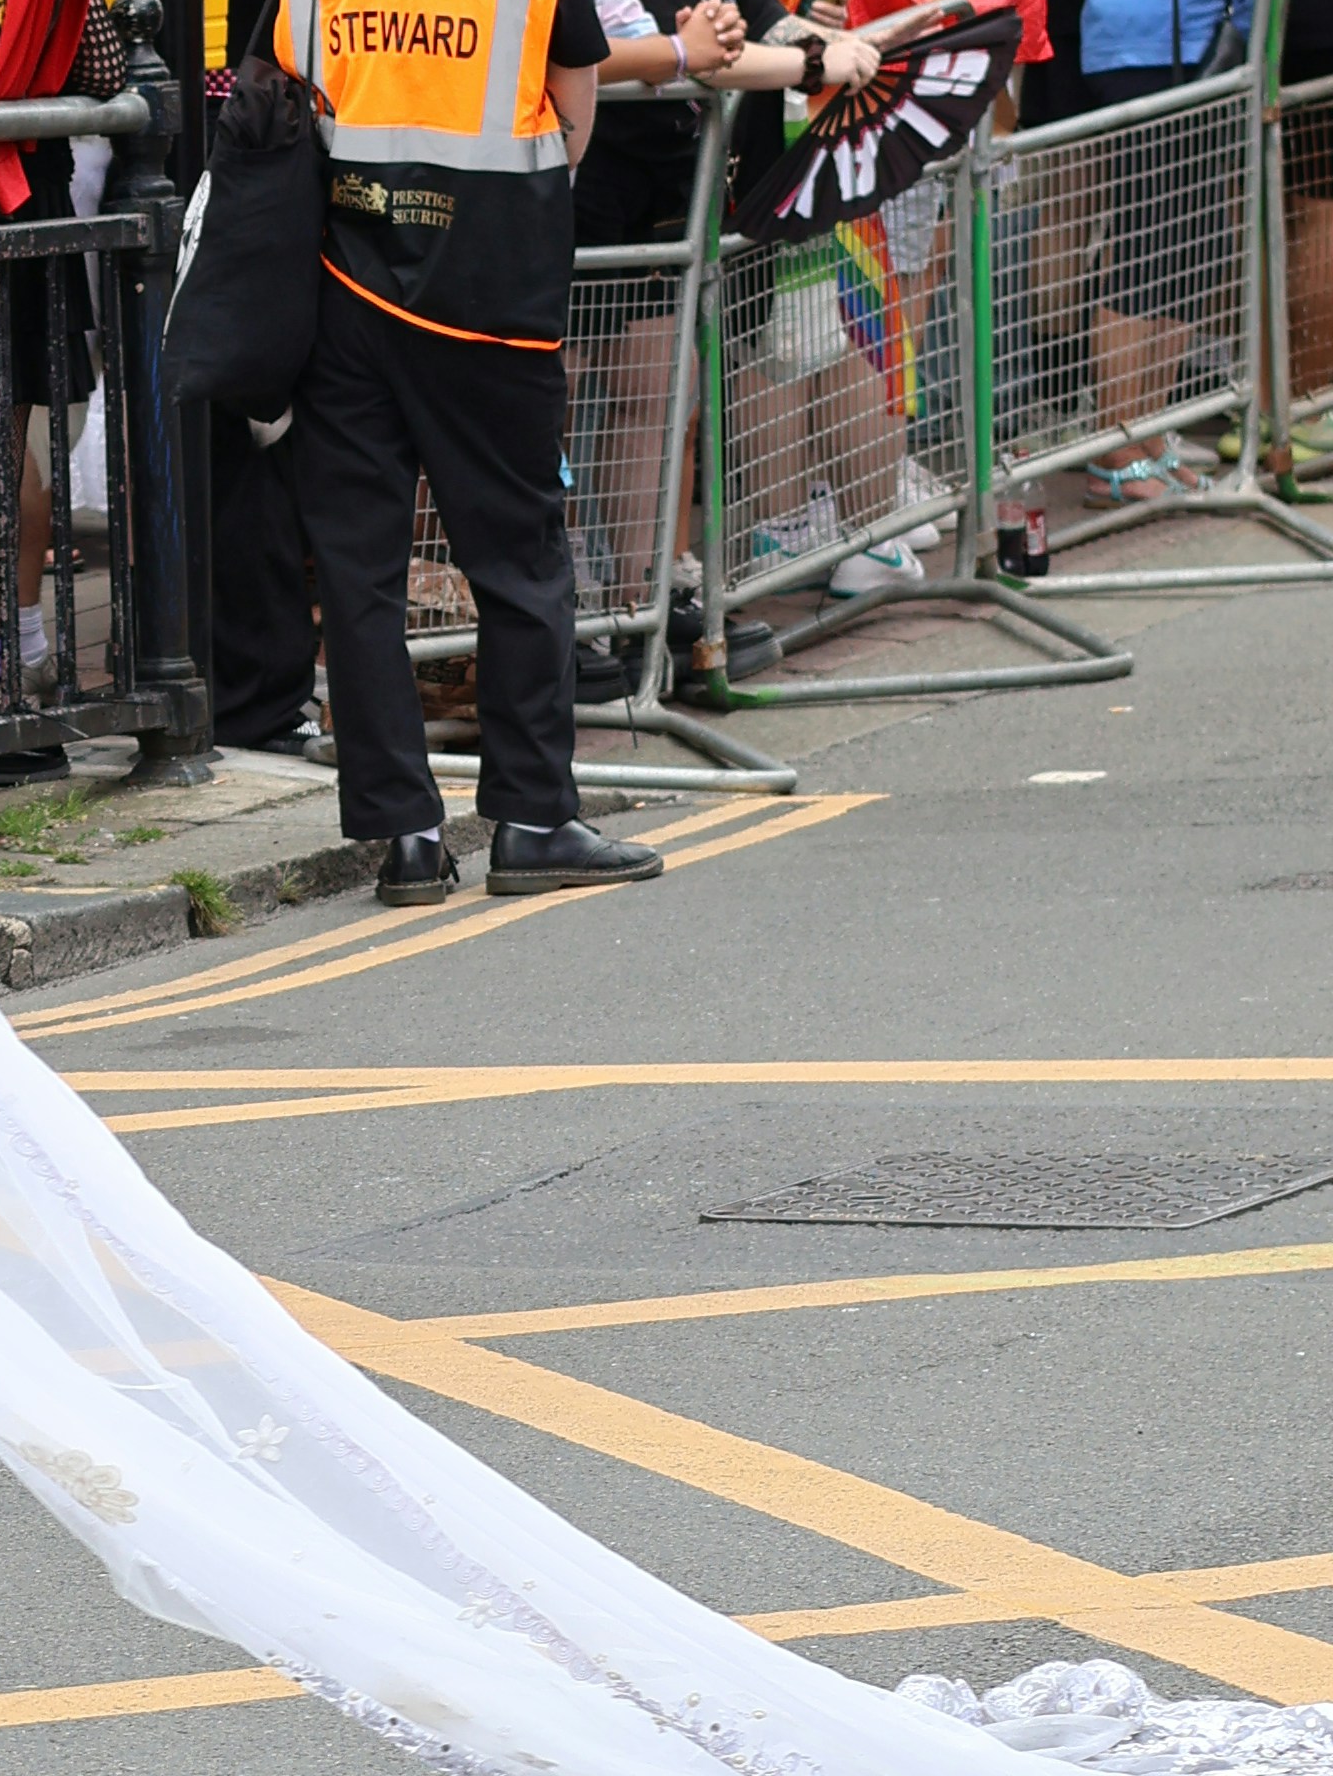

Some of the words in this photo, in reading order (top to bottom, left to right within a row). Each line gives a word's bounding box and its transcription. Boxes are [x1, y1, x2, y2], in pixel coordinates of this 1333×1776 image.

[329, 10, 479, 60] STEWARD
[391, 189, 456, 212] PRESTIGE
[391, 208, 454, 231] SECURITY
